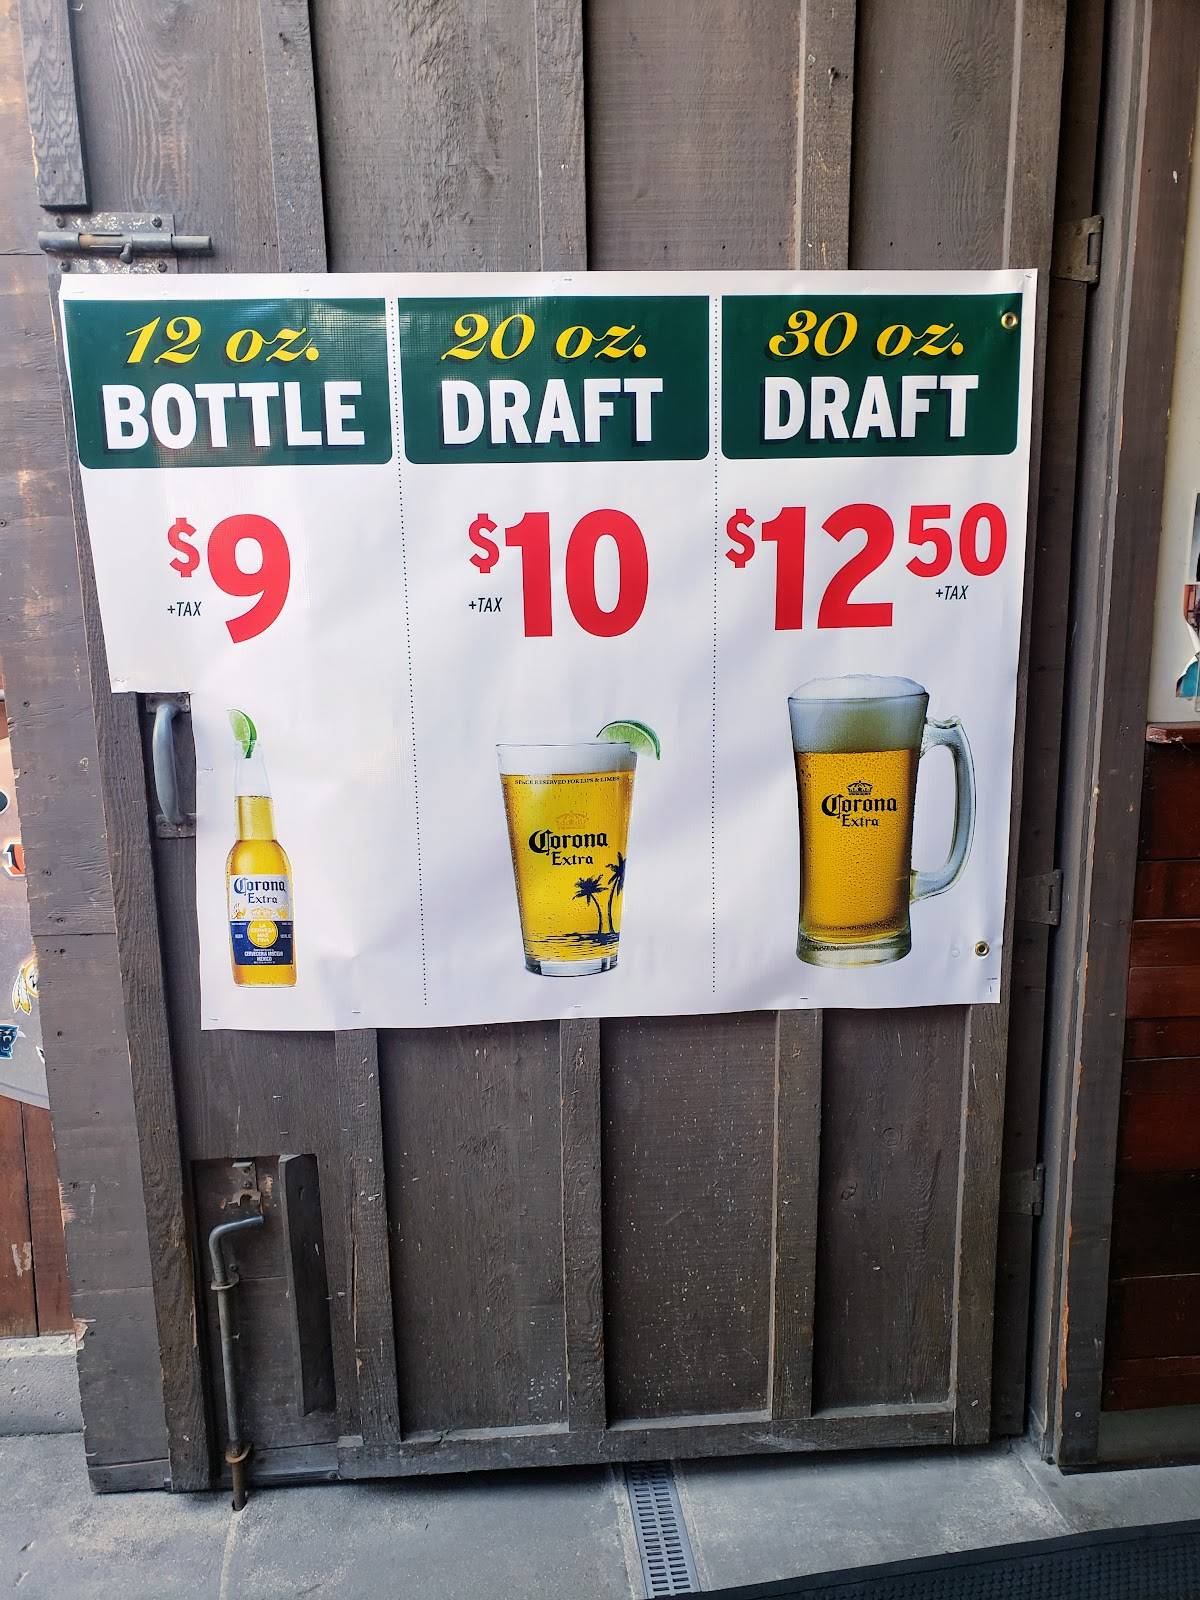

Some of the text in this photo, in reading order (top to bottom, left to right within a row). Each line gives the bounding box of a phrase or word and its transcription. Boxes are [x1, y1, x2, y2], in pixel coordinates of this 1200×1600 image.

[125, 315, 320, 364] 12 oz.
[440, 312, 648, 361] 20 oz.
[768, 309, 966, 358] 30 oz.
[101, 380, 366, 450] BOTTLE
[440, 377, 664, 445] DRAFT
[763, 374, 980, 441] DRAFT
[166, 513, 291, 644] $9
[468, 508, 649, 638] $10
[468, 597, 503, 613] +TAX
[935, 585, 969, 601] +TAX
[167, 601, 202, 617] +TAX
[821, 793, 898, 819] Corona
[841, 813, 880, 827] Extra
[528, 829, 609, 856] Corona
[550, 851, 594, 866] Extra
[233, 877, 287, 896] Corona
[247, 892, 278, 904] Extra
